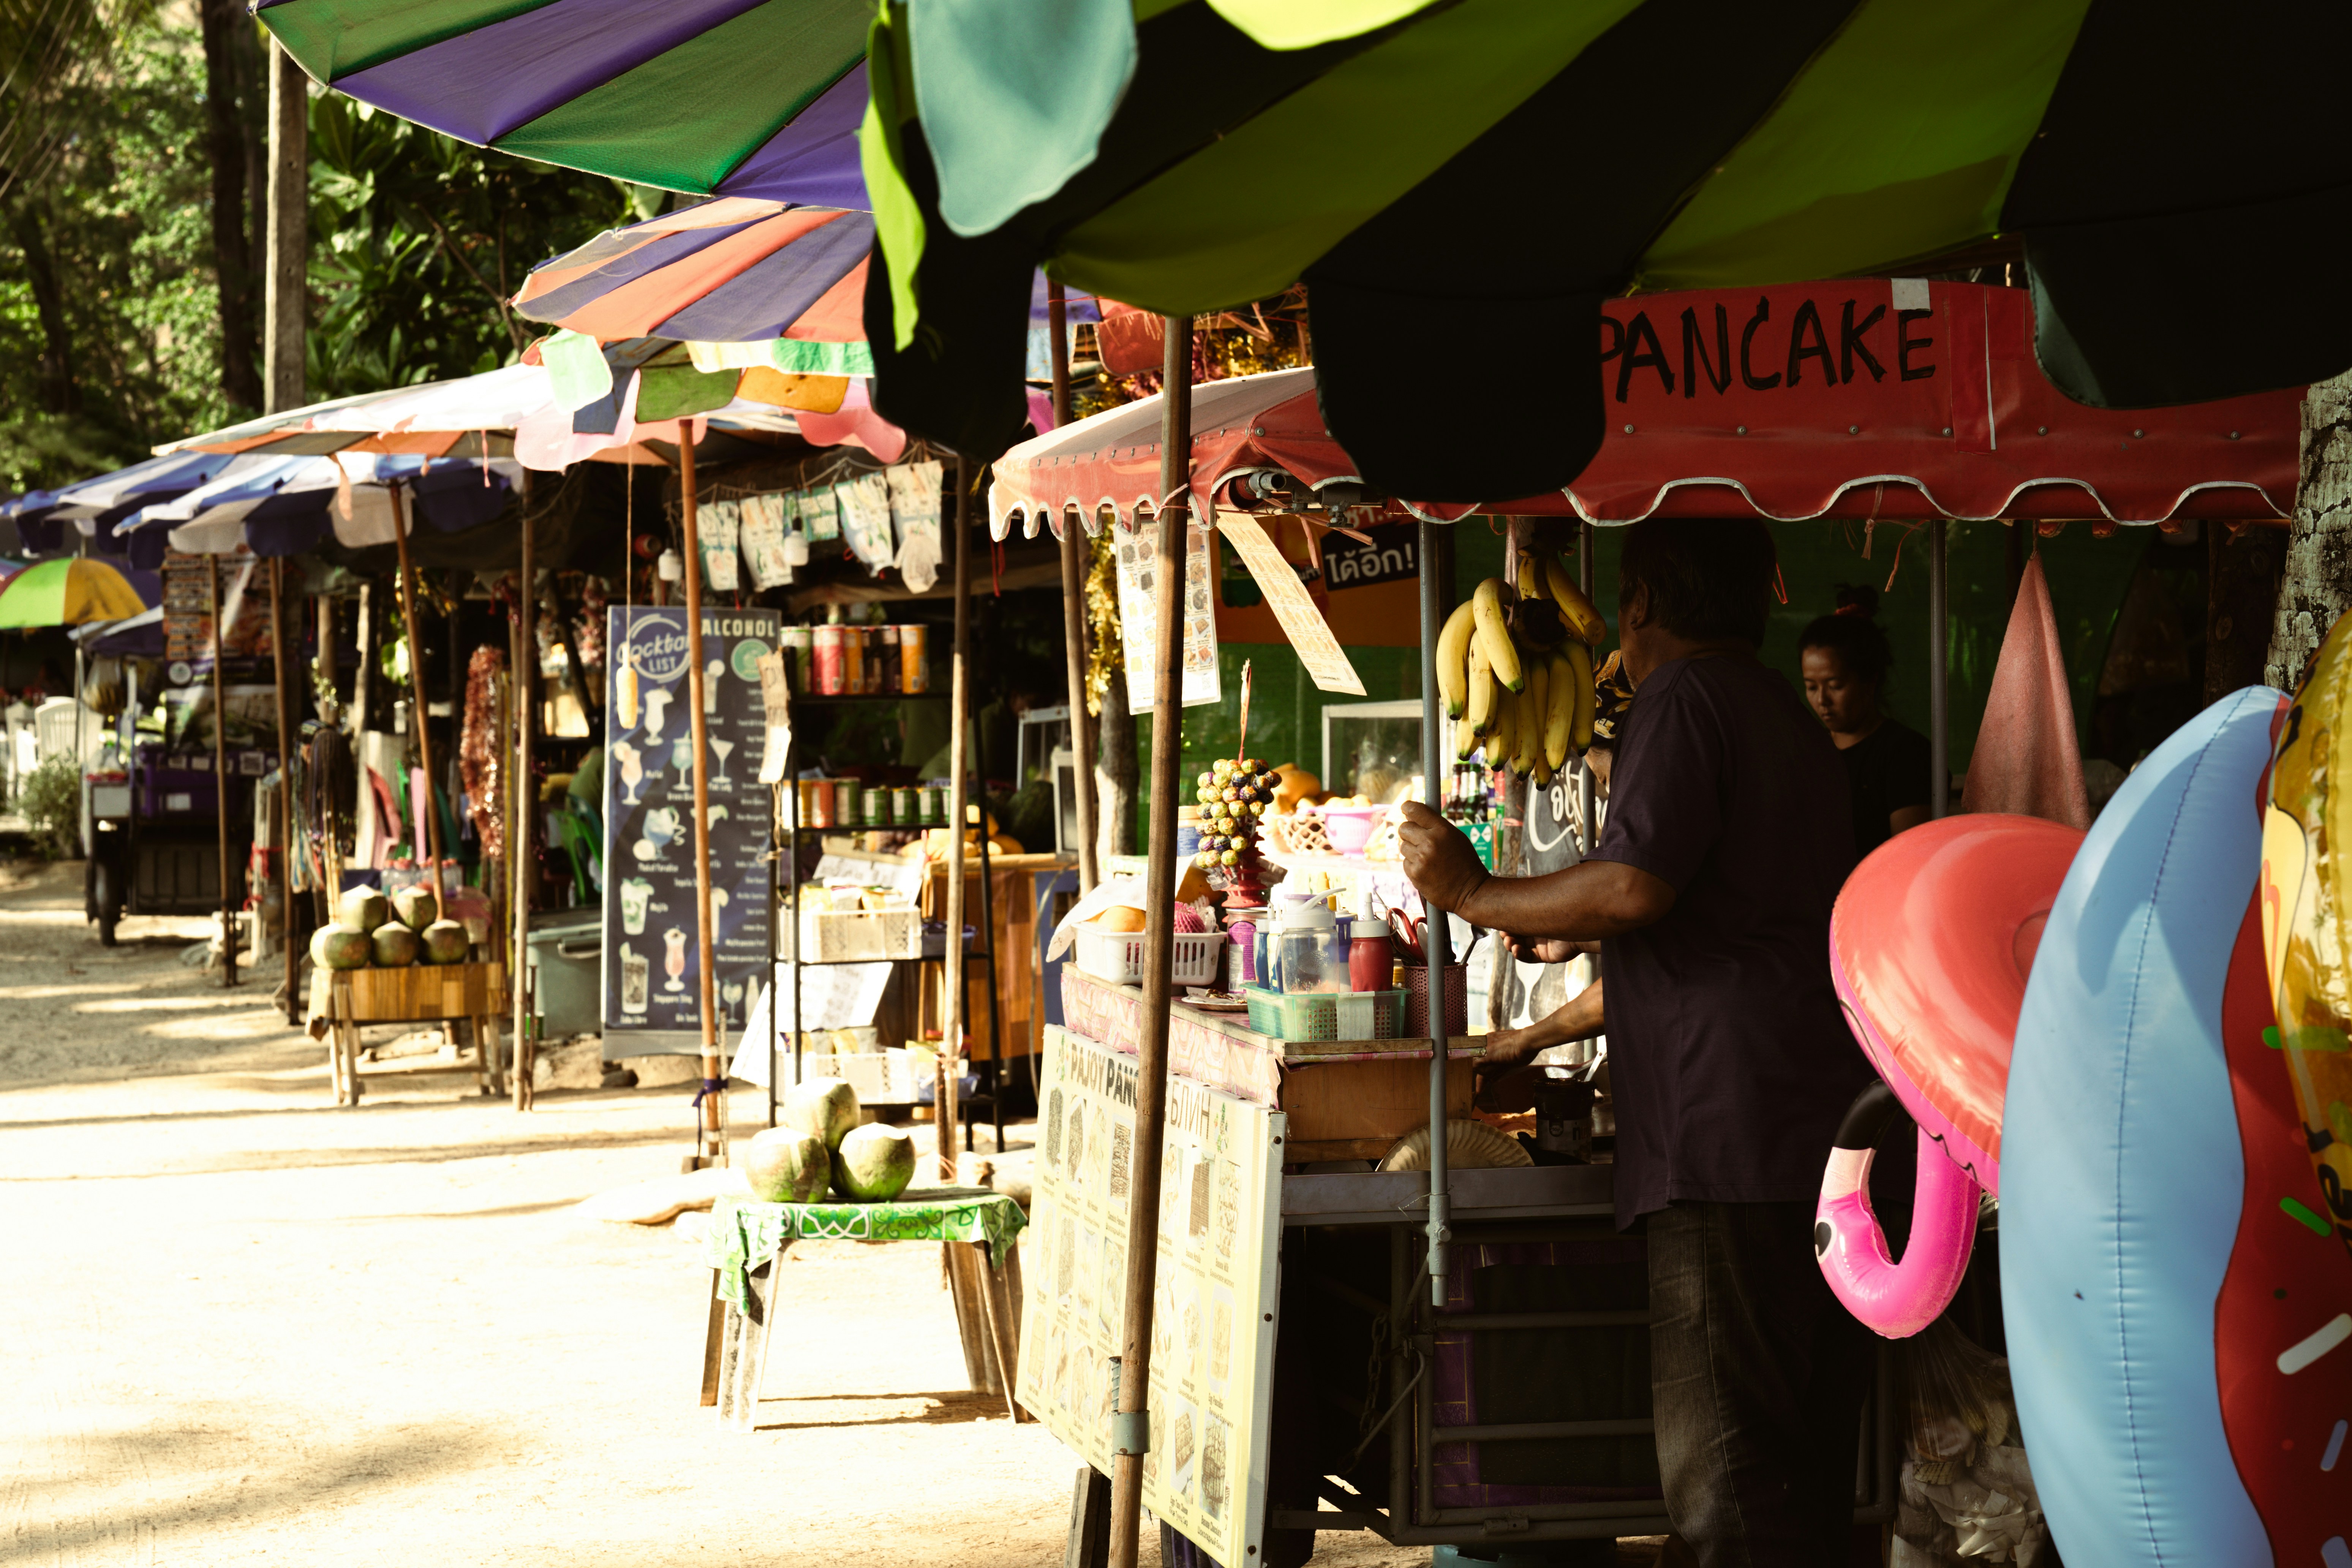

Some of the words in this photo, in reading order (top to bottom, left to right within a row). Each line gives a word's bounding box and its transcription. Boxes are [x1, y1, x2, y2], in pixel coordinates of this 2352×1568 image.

[1325, 542, 1414, 583] ได้อีก!
[701, 619, 775, 637] ALCOHOL
[648, 658, 676, 673] LIST
[1070, 1043, 1106, 1094] PAJOY
[1170, 1080, 1211, 1141] БЛИН
